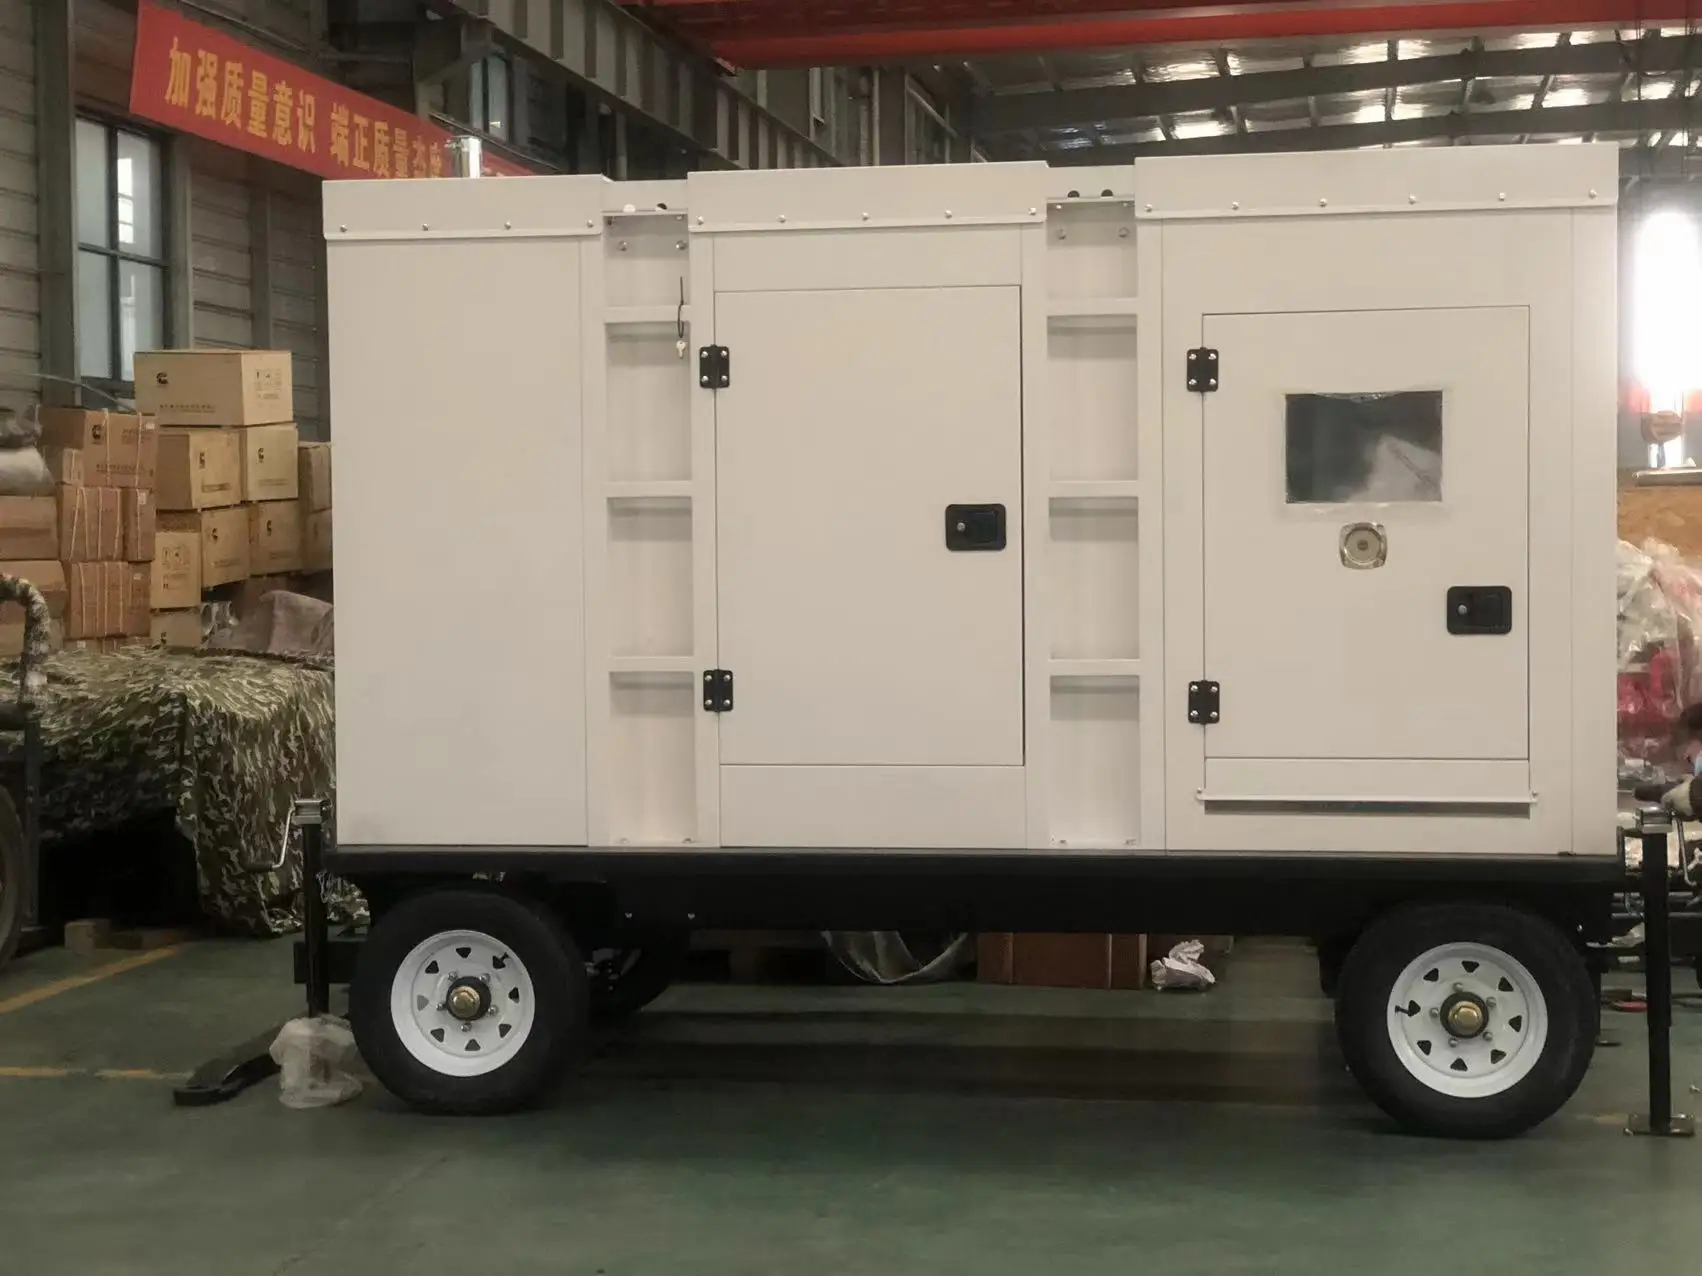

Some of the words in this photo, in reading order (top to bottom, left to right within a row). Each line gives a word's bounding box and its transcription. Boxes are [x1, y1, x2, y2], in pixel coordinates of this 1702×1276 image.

[164, 36, 316, 154] 加强质量意识
